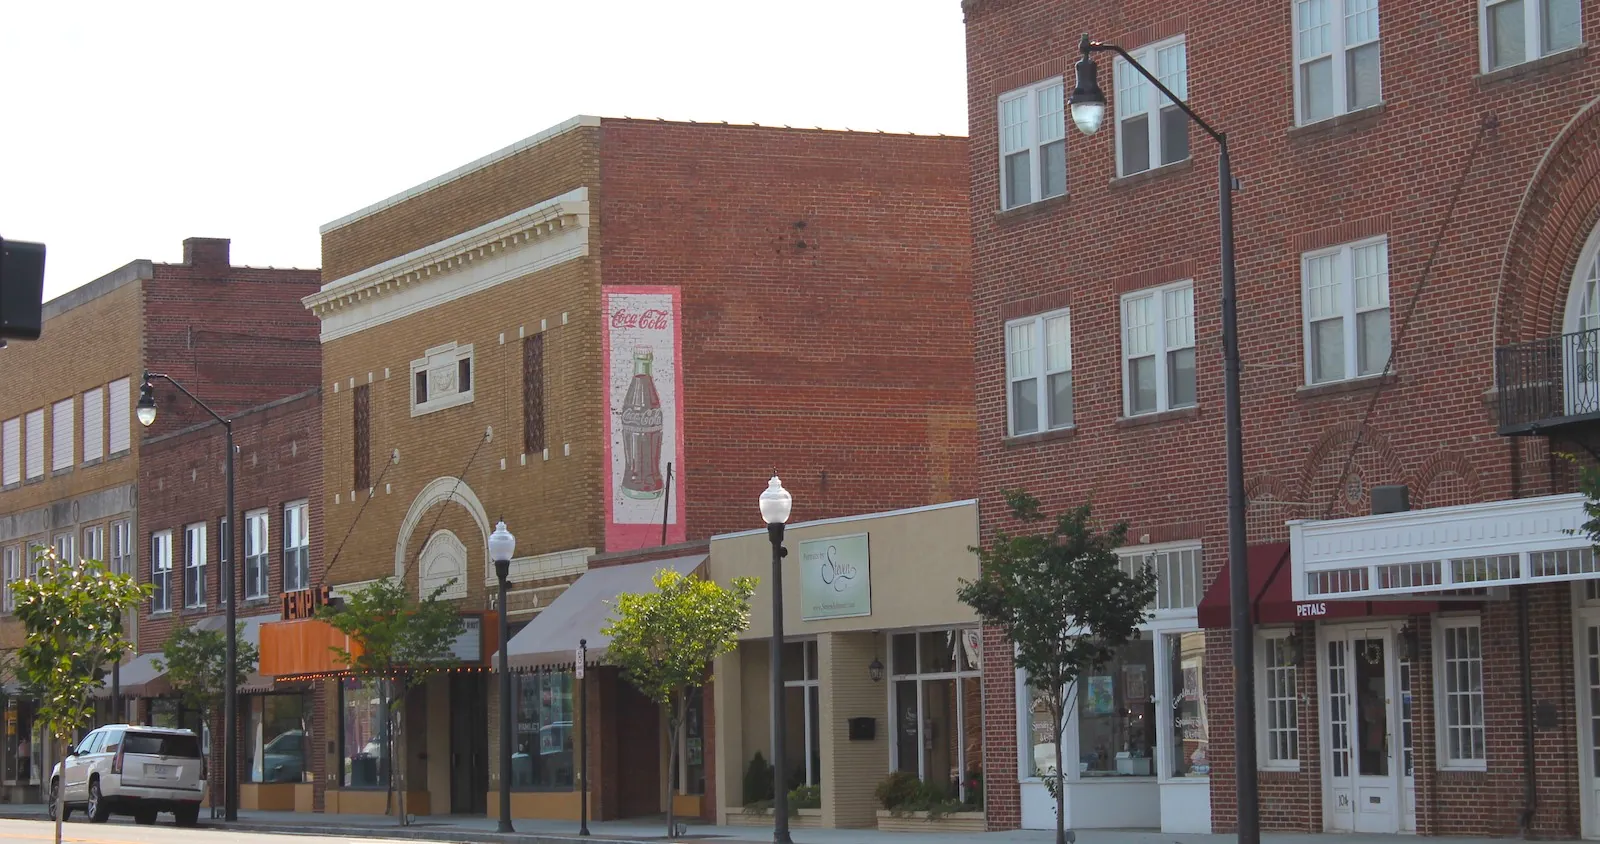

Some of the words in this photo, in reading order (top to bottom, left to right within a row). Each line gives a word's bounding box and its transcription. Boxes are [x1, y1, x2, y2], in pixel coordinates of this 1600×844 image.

[612, 308, 668, 330] Coca-Cola
[622, 407, 661, 426] Coca-Cola
[821, 545, 857, 592] Steven
[280, 584, 328, 621] TEMPLE
[1297, 603, 1326, 616] PETALS
